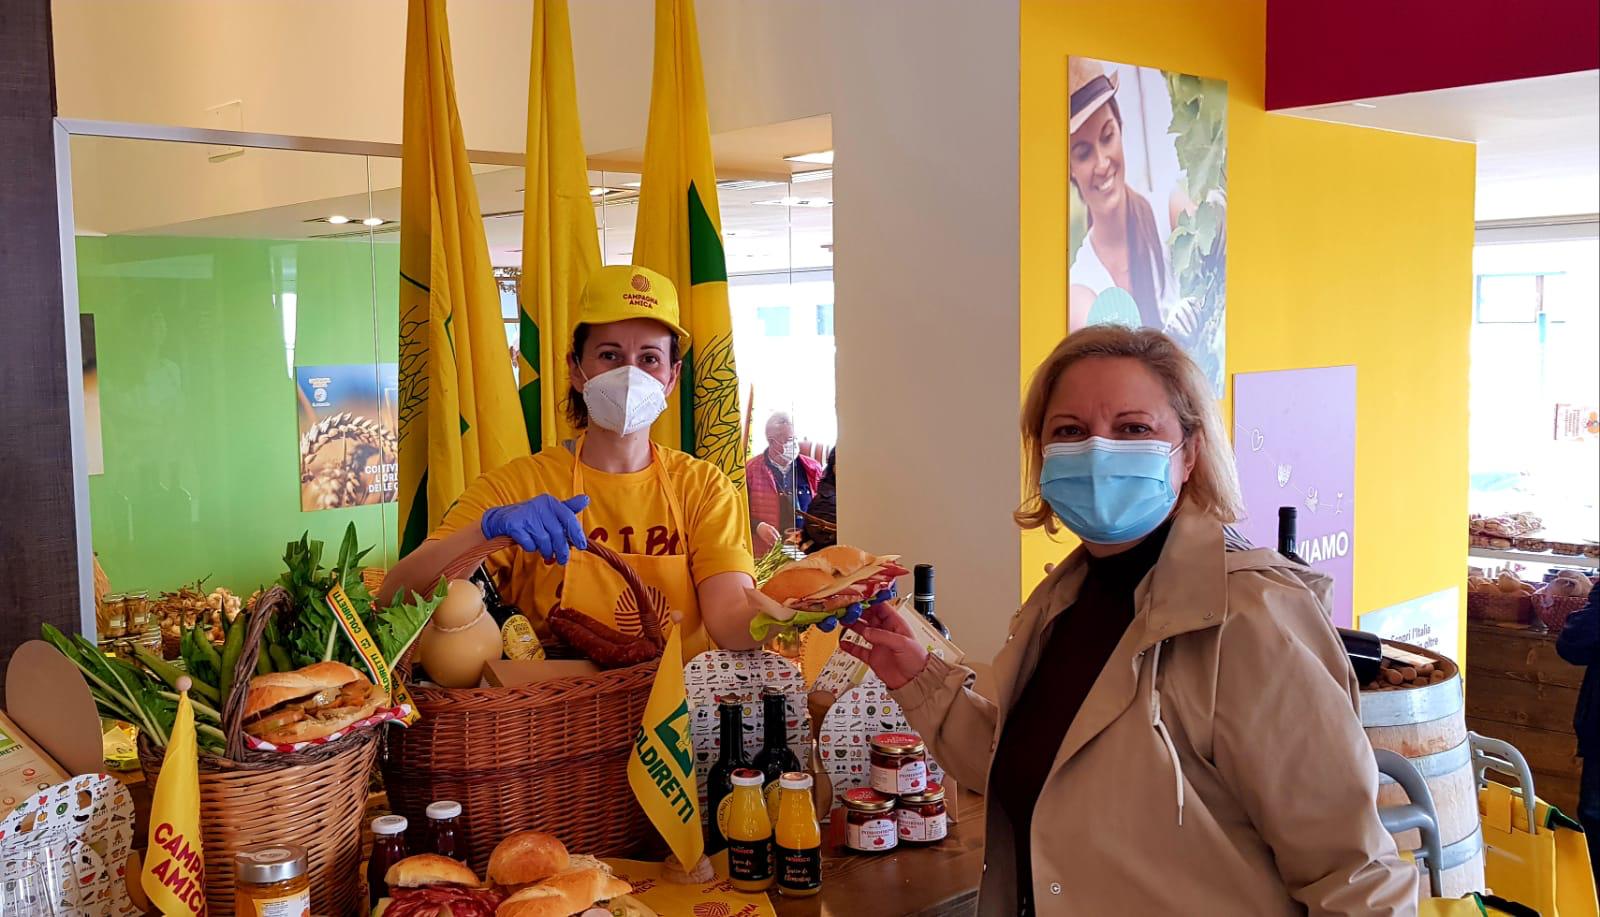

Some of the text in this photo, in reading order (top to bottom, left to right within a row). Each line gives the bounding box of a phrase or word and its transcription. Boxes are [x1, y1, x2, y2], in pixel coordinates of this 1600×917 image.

[622, 294, 658, 305] CAMPAGNA
[629, 300, 653, 309] AMICA
[332, 591, 361, 634] COLDIRETTI
[370, 653, 390, 695] OLDIRETTI
